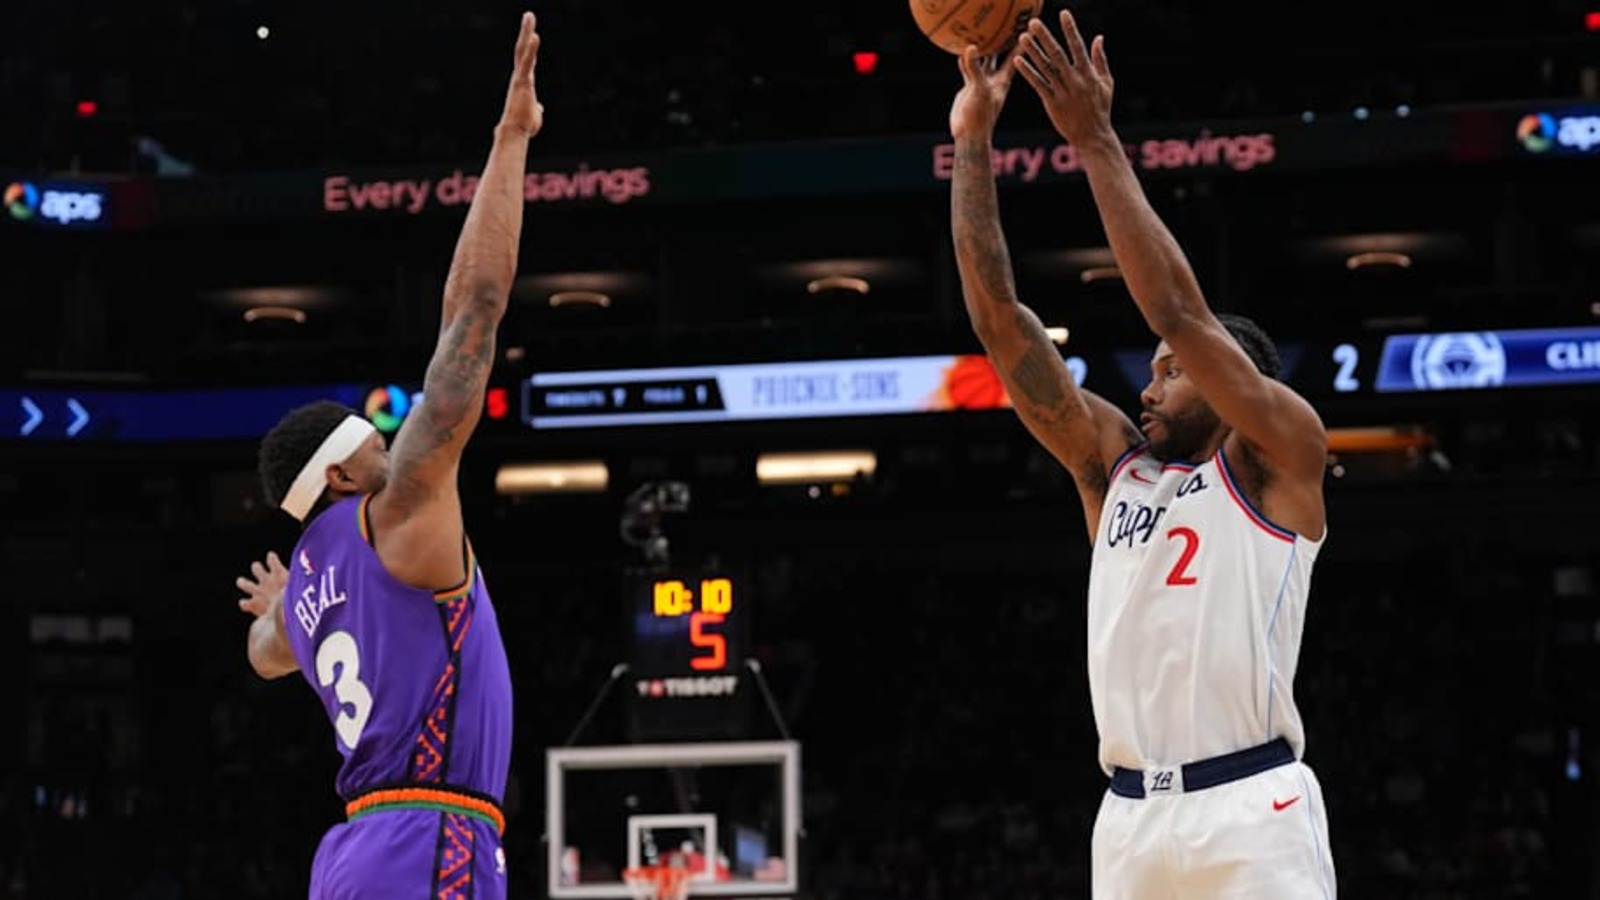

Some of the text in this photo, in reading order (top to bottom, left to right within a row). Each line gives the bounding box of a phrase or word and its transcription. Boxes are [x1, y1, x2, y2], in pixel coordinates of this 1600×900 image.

[933, 142, 1046, 182] Eery
[1141, 128, 1276, 171] savings
[1558, 116, 1600, 152] ap
[41, 190, 102, 225] aps
[323, 162, 650, 214] Every da savings
[1332, 343, 1361, 393] 2
[1546, 340, 1600, 370] CLI
[1107, 472, 1209, 549] Clipps
[1165, 526, 1201, 587] 2
[294, 565, 347, 638] BEAL
[653, 578, 733, 617] 10:10
[690, 611, 727, 670] 5
[315, 630, 374, 751] 3
[664, 675, 738, 697] TISSOT
